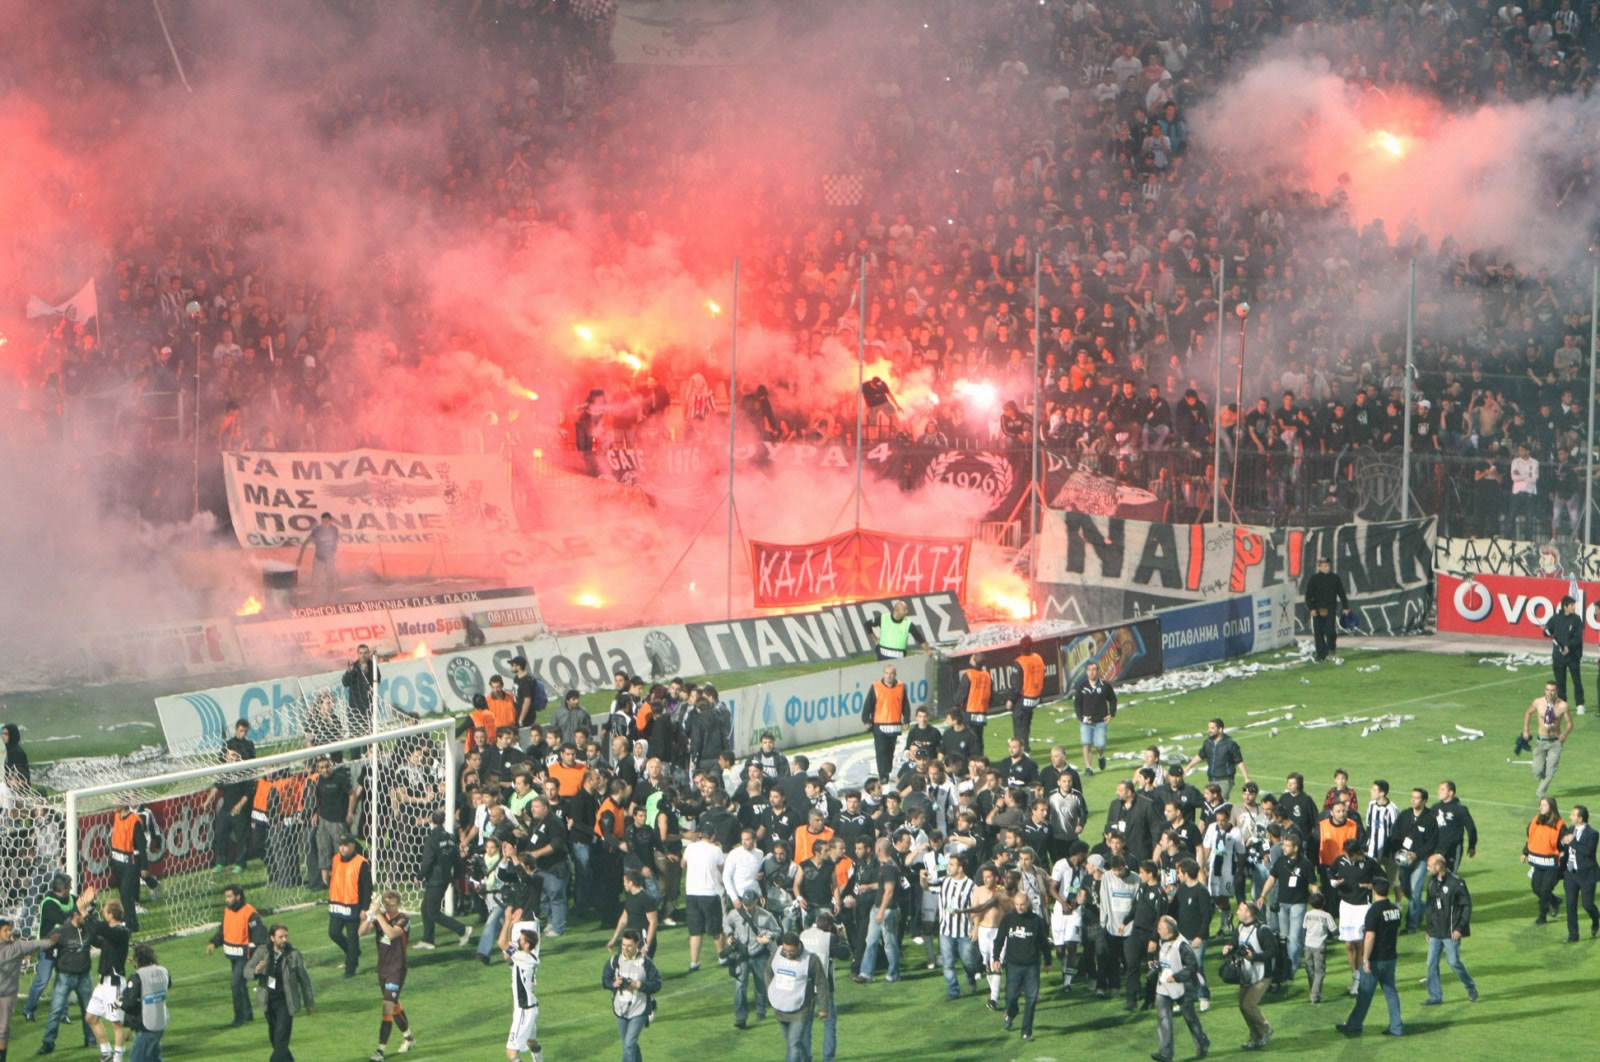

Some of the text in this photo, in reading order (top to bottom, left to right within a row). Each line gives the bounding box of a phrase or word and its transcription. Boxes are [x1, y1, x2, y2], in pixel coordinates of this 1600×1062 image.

[229, 452, 279, 478] ΤΑ
[867, 443, 892, 463] 4
[945, 471, 996, 493] 1926
[243, 482, 318, 509] ΜΑΣ
[758, 541, 965, 598] ΚΑΛΑ ΜΑΤΑ
[784, 683, 864, 728] Φυσικό
